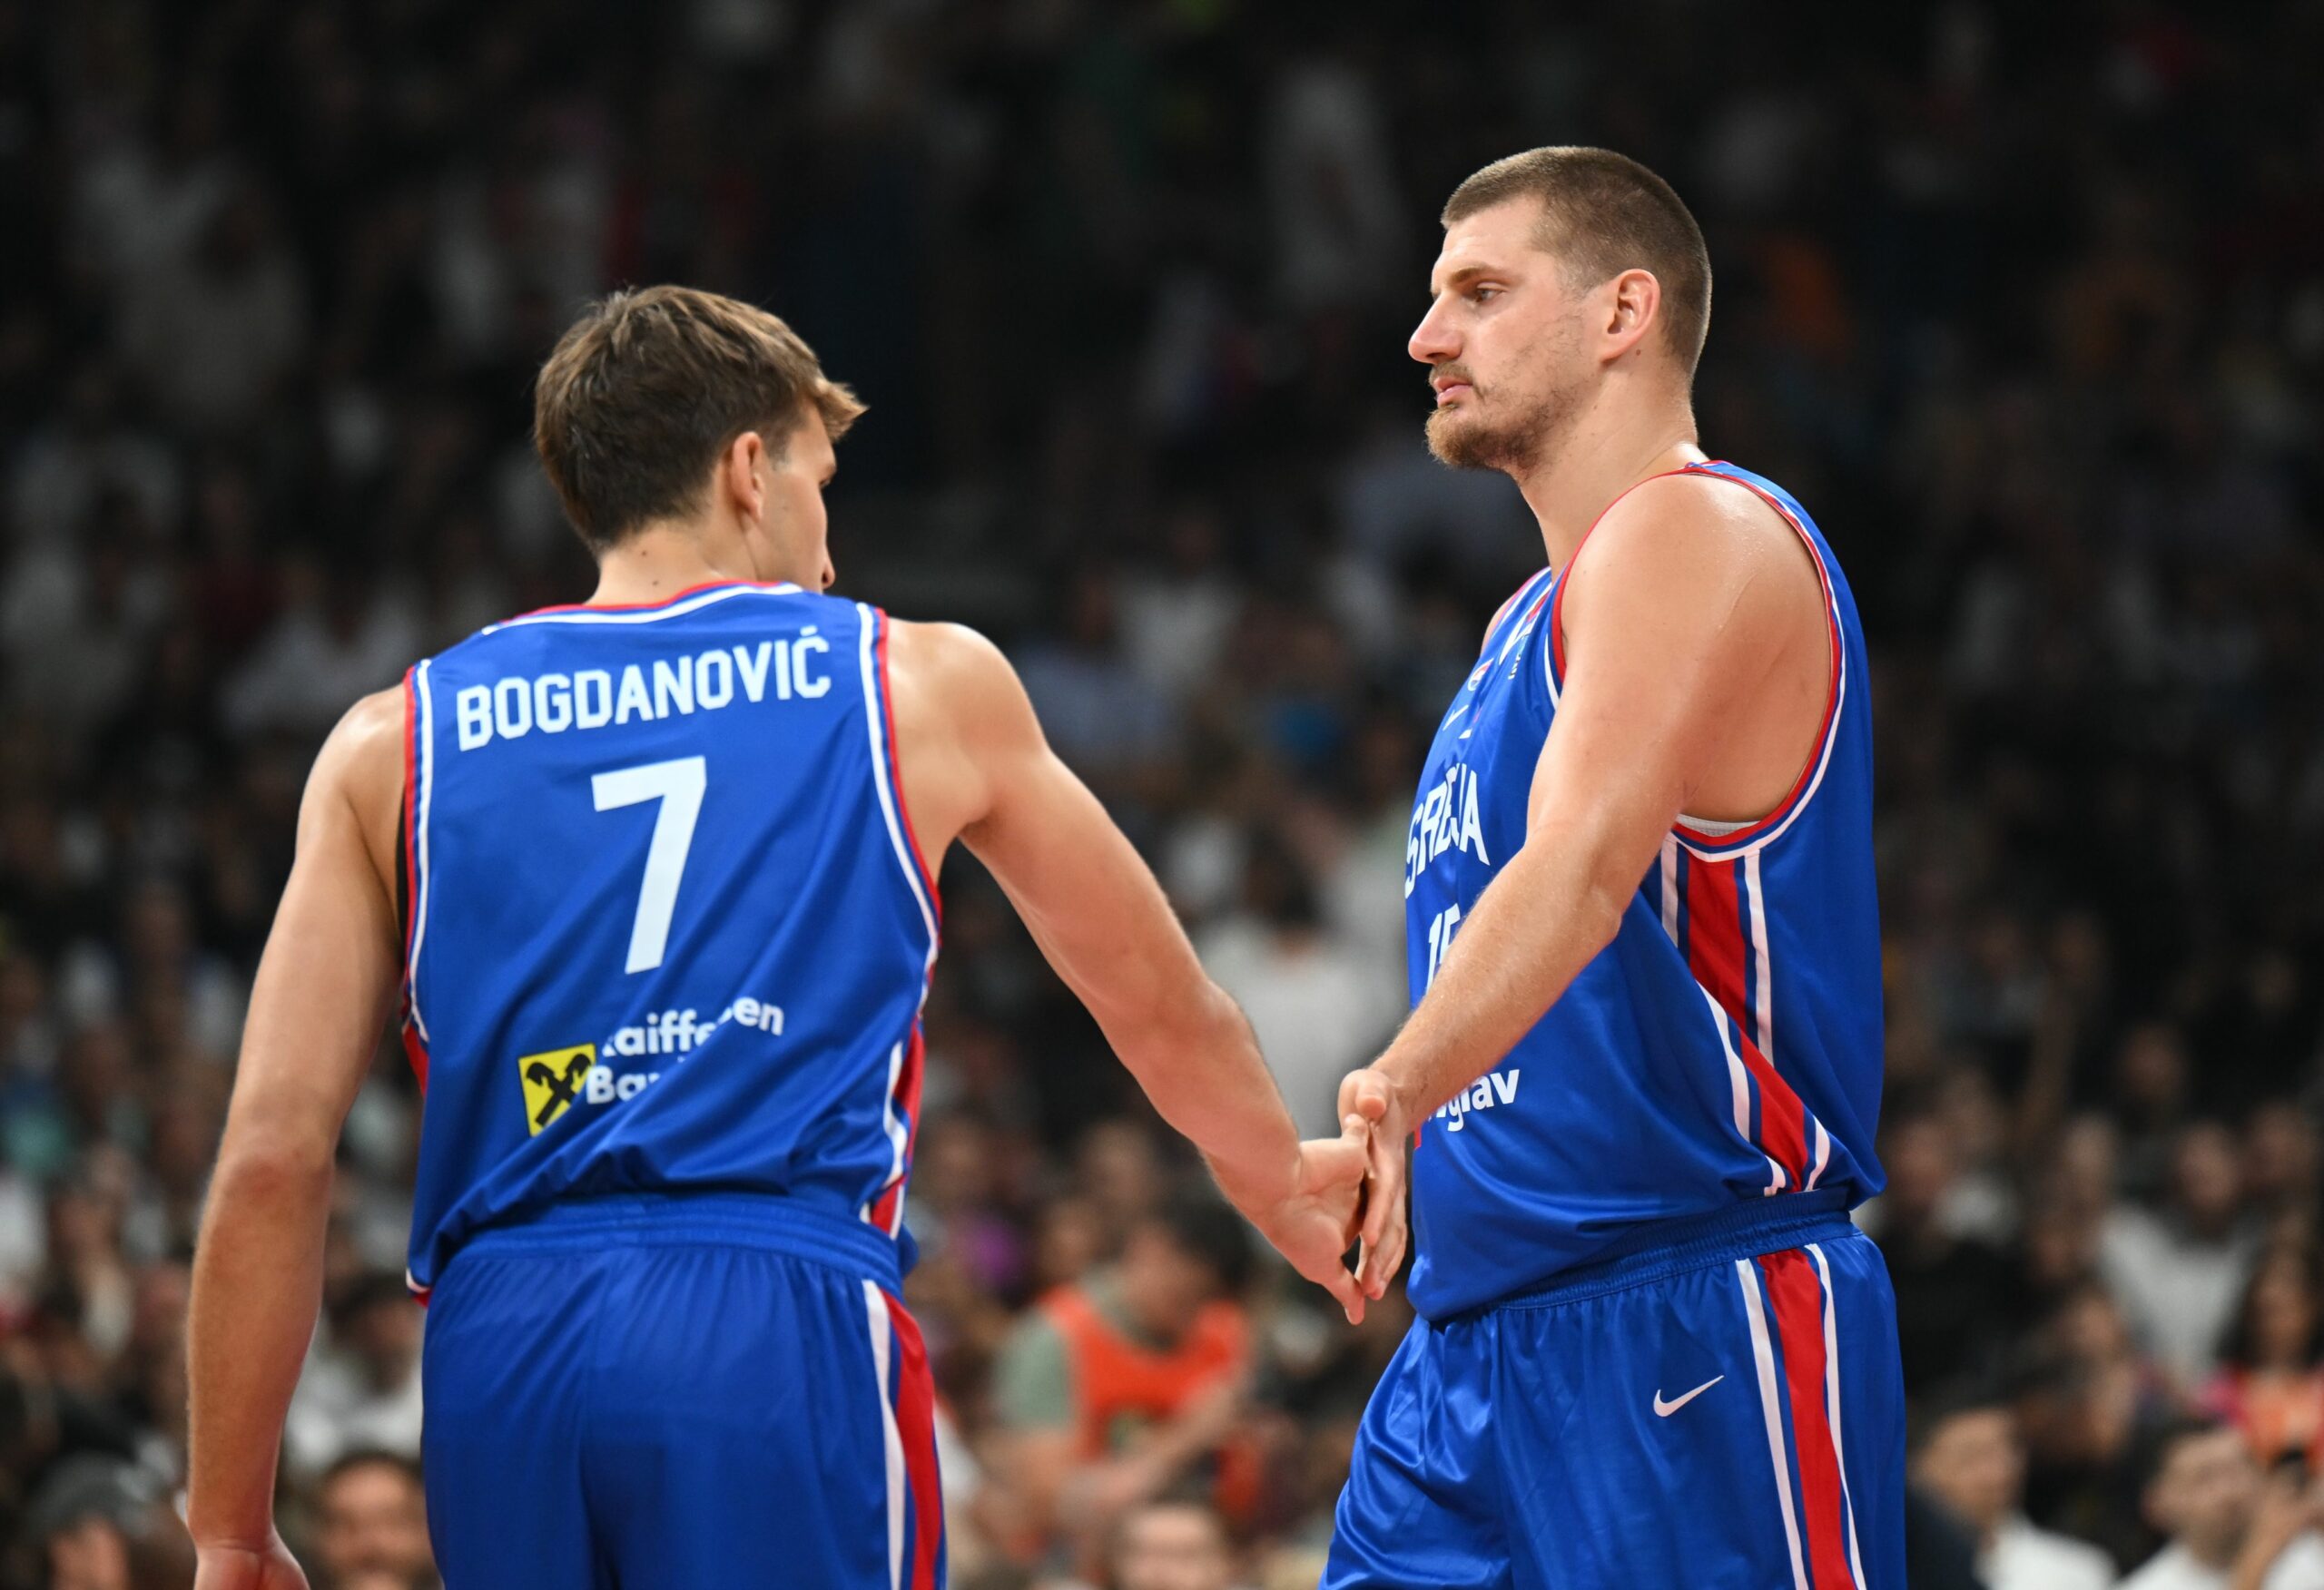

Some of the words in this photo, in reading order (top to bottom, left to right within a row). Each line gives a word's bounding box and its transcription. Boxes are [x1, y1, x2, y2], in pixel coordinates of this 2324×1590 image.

[457, 626, 831, 751] BOGDANOVIĆ
[591, 755, 707, 975] 7
[586, 1060, 685, 1104] Ba
